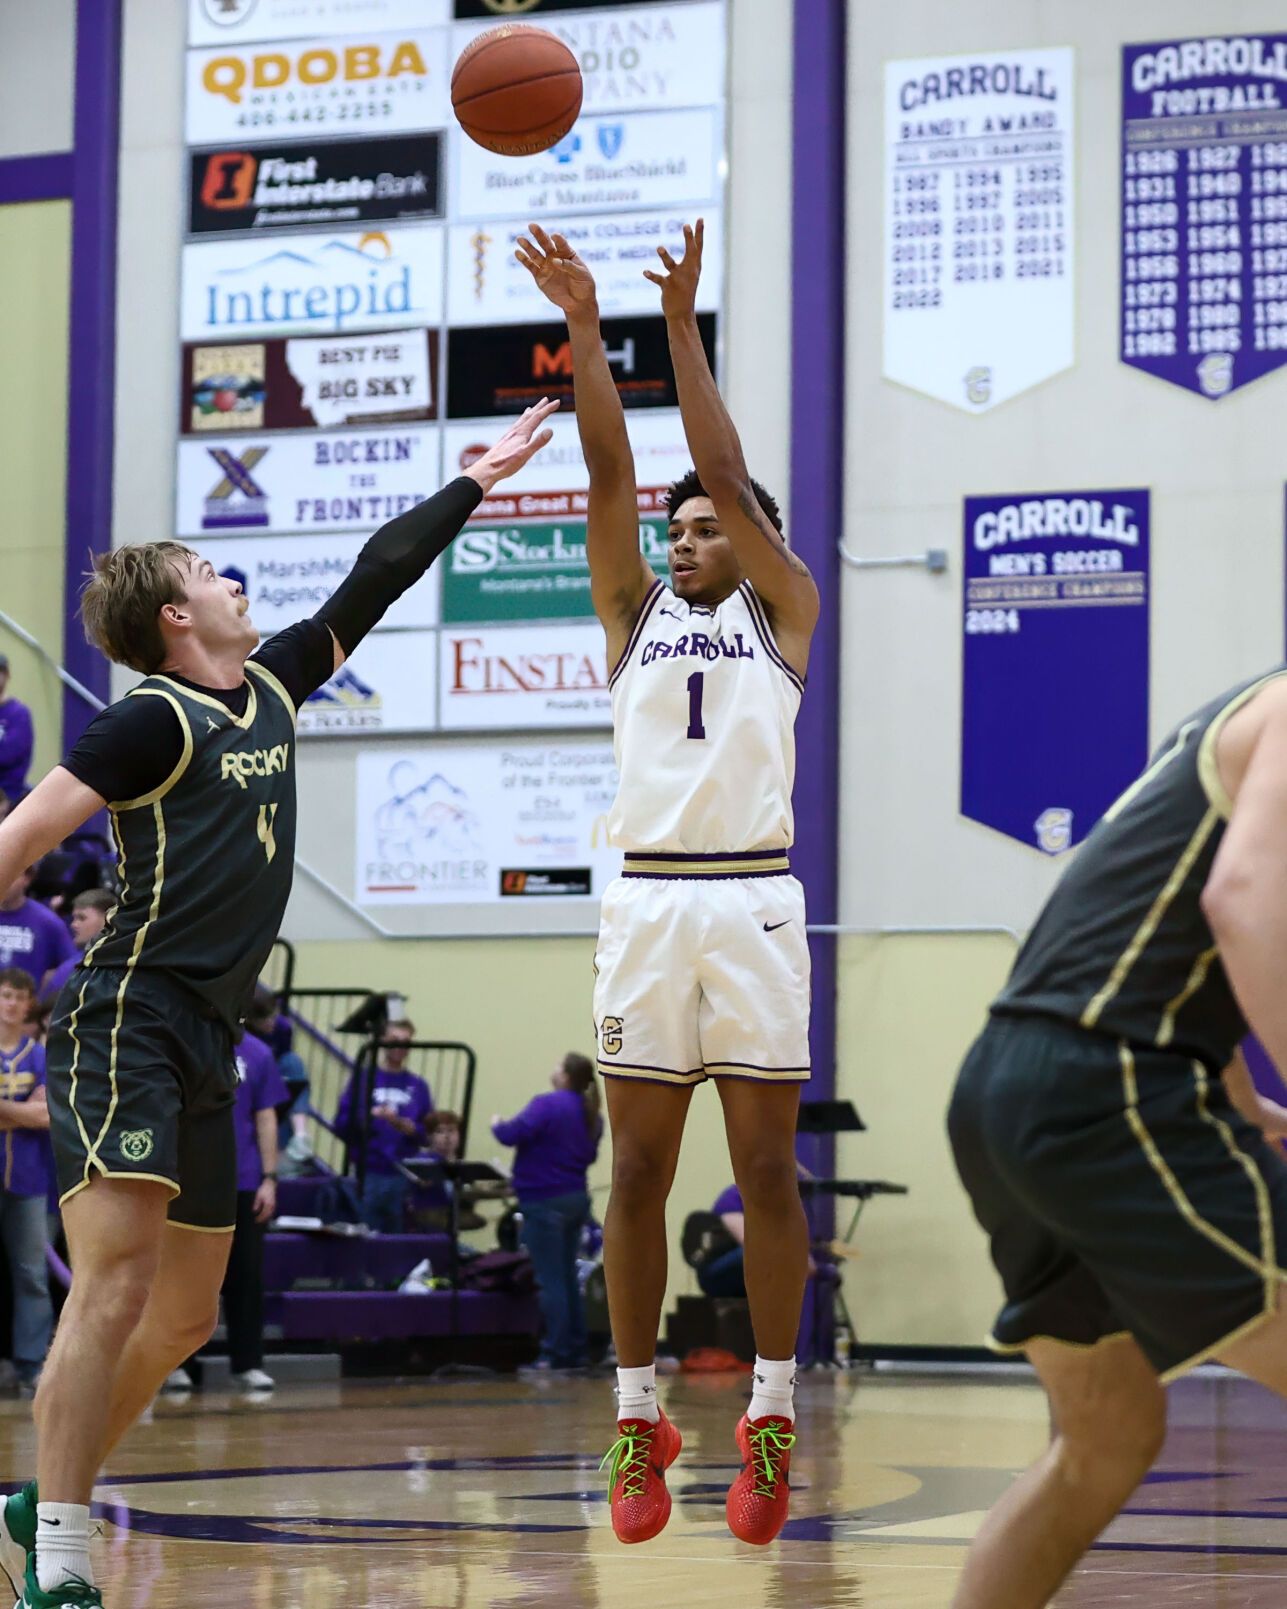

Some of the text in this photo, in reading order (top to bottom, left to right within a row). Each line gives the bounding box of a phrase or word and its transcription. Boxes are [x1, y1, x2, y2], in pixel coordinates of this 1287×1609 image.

[202, 40, 428, 105] QDOBA
[899, 63, 1057, 112] CARROLL
[1151, 83, 1282, 117] FOOTBALL
[206, 265, 413, 331] Intrepid
[317, 374, 416, 400] BIG SKY
[973, 498, 1140, 551] CARROLL
[988, 549, 1124, 576] MEN'S SOCCER
[965, 608, 1020, 635] 2024
[641, 632, 754, 667] CARROLL
[686, 671, 706, 740] 1
[220, 742, 289, 789] ROCKY
[256, 802, 279, 865] 4
[366, 860, 490, 883] FRONTIER
